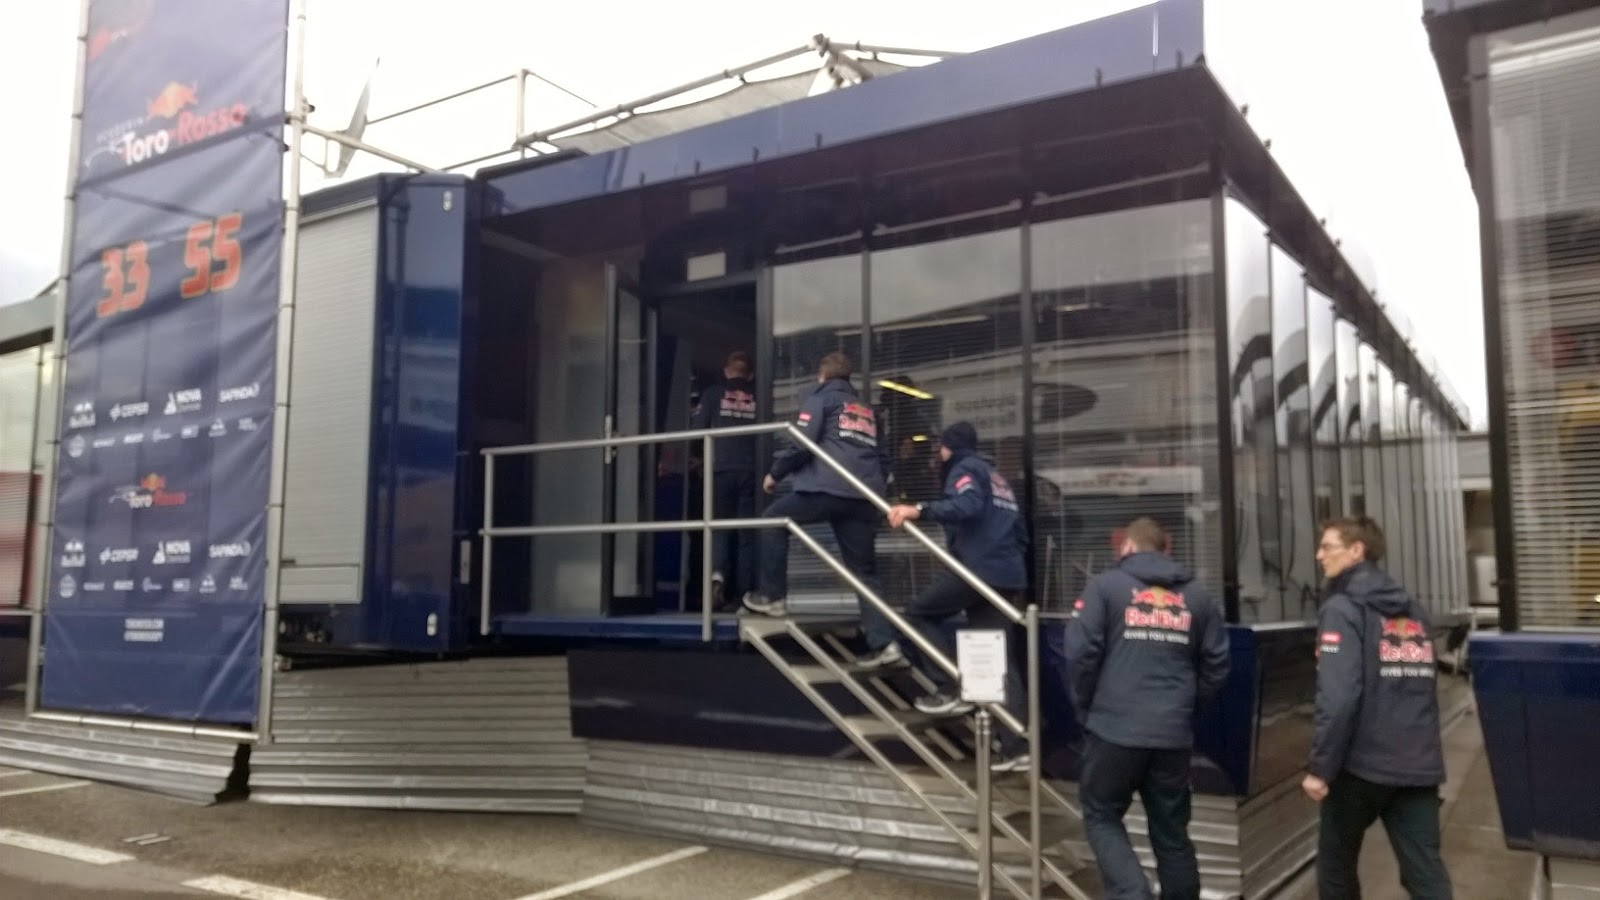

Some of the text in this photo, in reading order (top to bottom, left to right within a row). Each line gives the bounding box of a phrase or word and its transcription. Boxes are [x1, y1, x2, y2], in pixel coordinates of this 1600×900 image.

[122, 129, 169, 165] Toro
[177, 103, 248, 145] Rosso
[96, 211, 243, 319] 33 55
[1124, 605, 1192, 633] Red Bull
[1379, 639, 1434, 664] Red Bull
